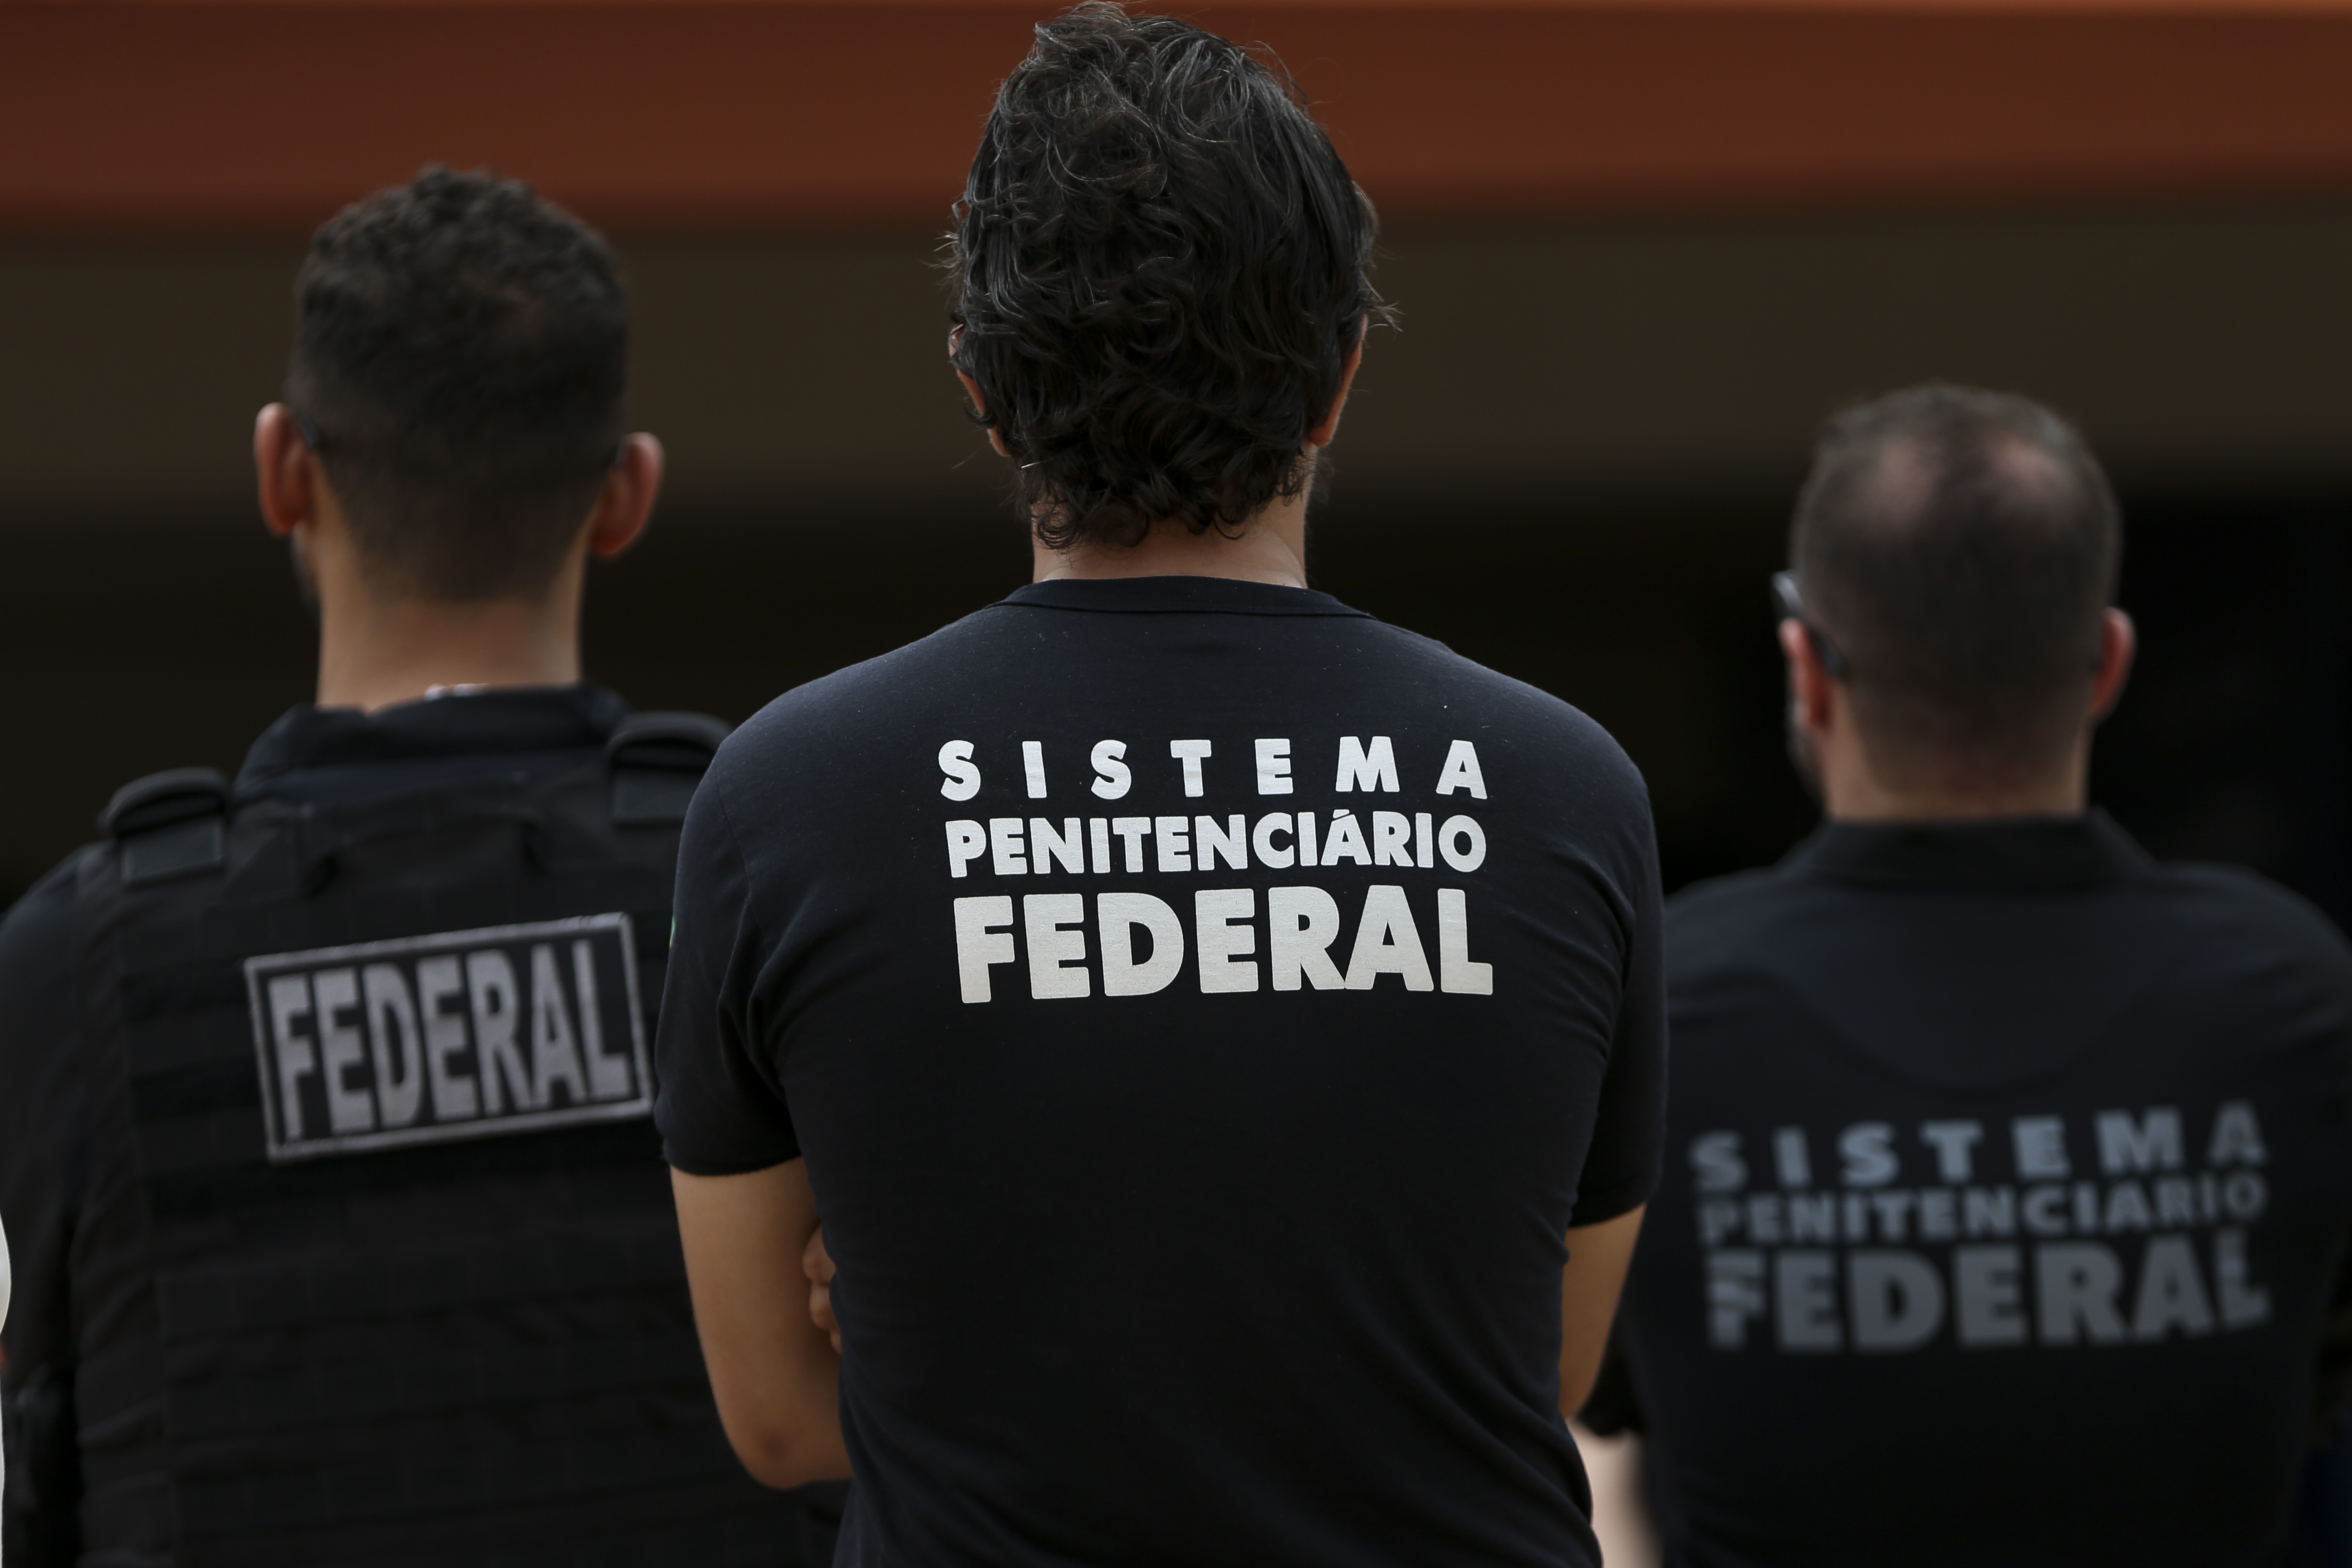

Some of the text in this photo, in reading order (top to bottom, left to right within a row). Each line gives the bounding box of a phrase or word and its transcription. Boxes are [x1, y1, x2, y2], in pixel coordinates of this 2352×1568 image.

[937, 736, 1488, 801] SISTEMA
[945, 809, 1487, 878] PENITENCIÁRIO
[953, 885, 1494, 1004] FEDERAL
[267, 938, 632, 1140] FEDERAL
[1689, 1101, 2268, 1191] SISTEMA
[1707, 1230, 2270, 1352] FEDERAL
